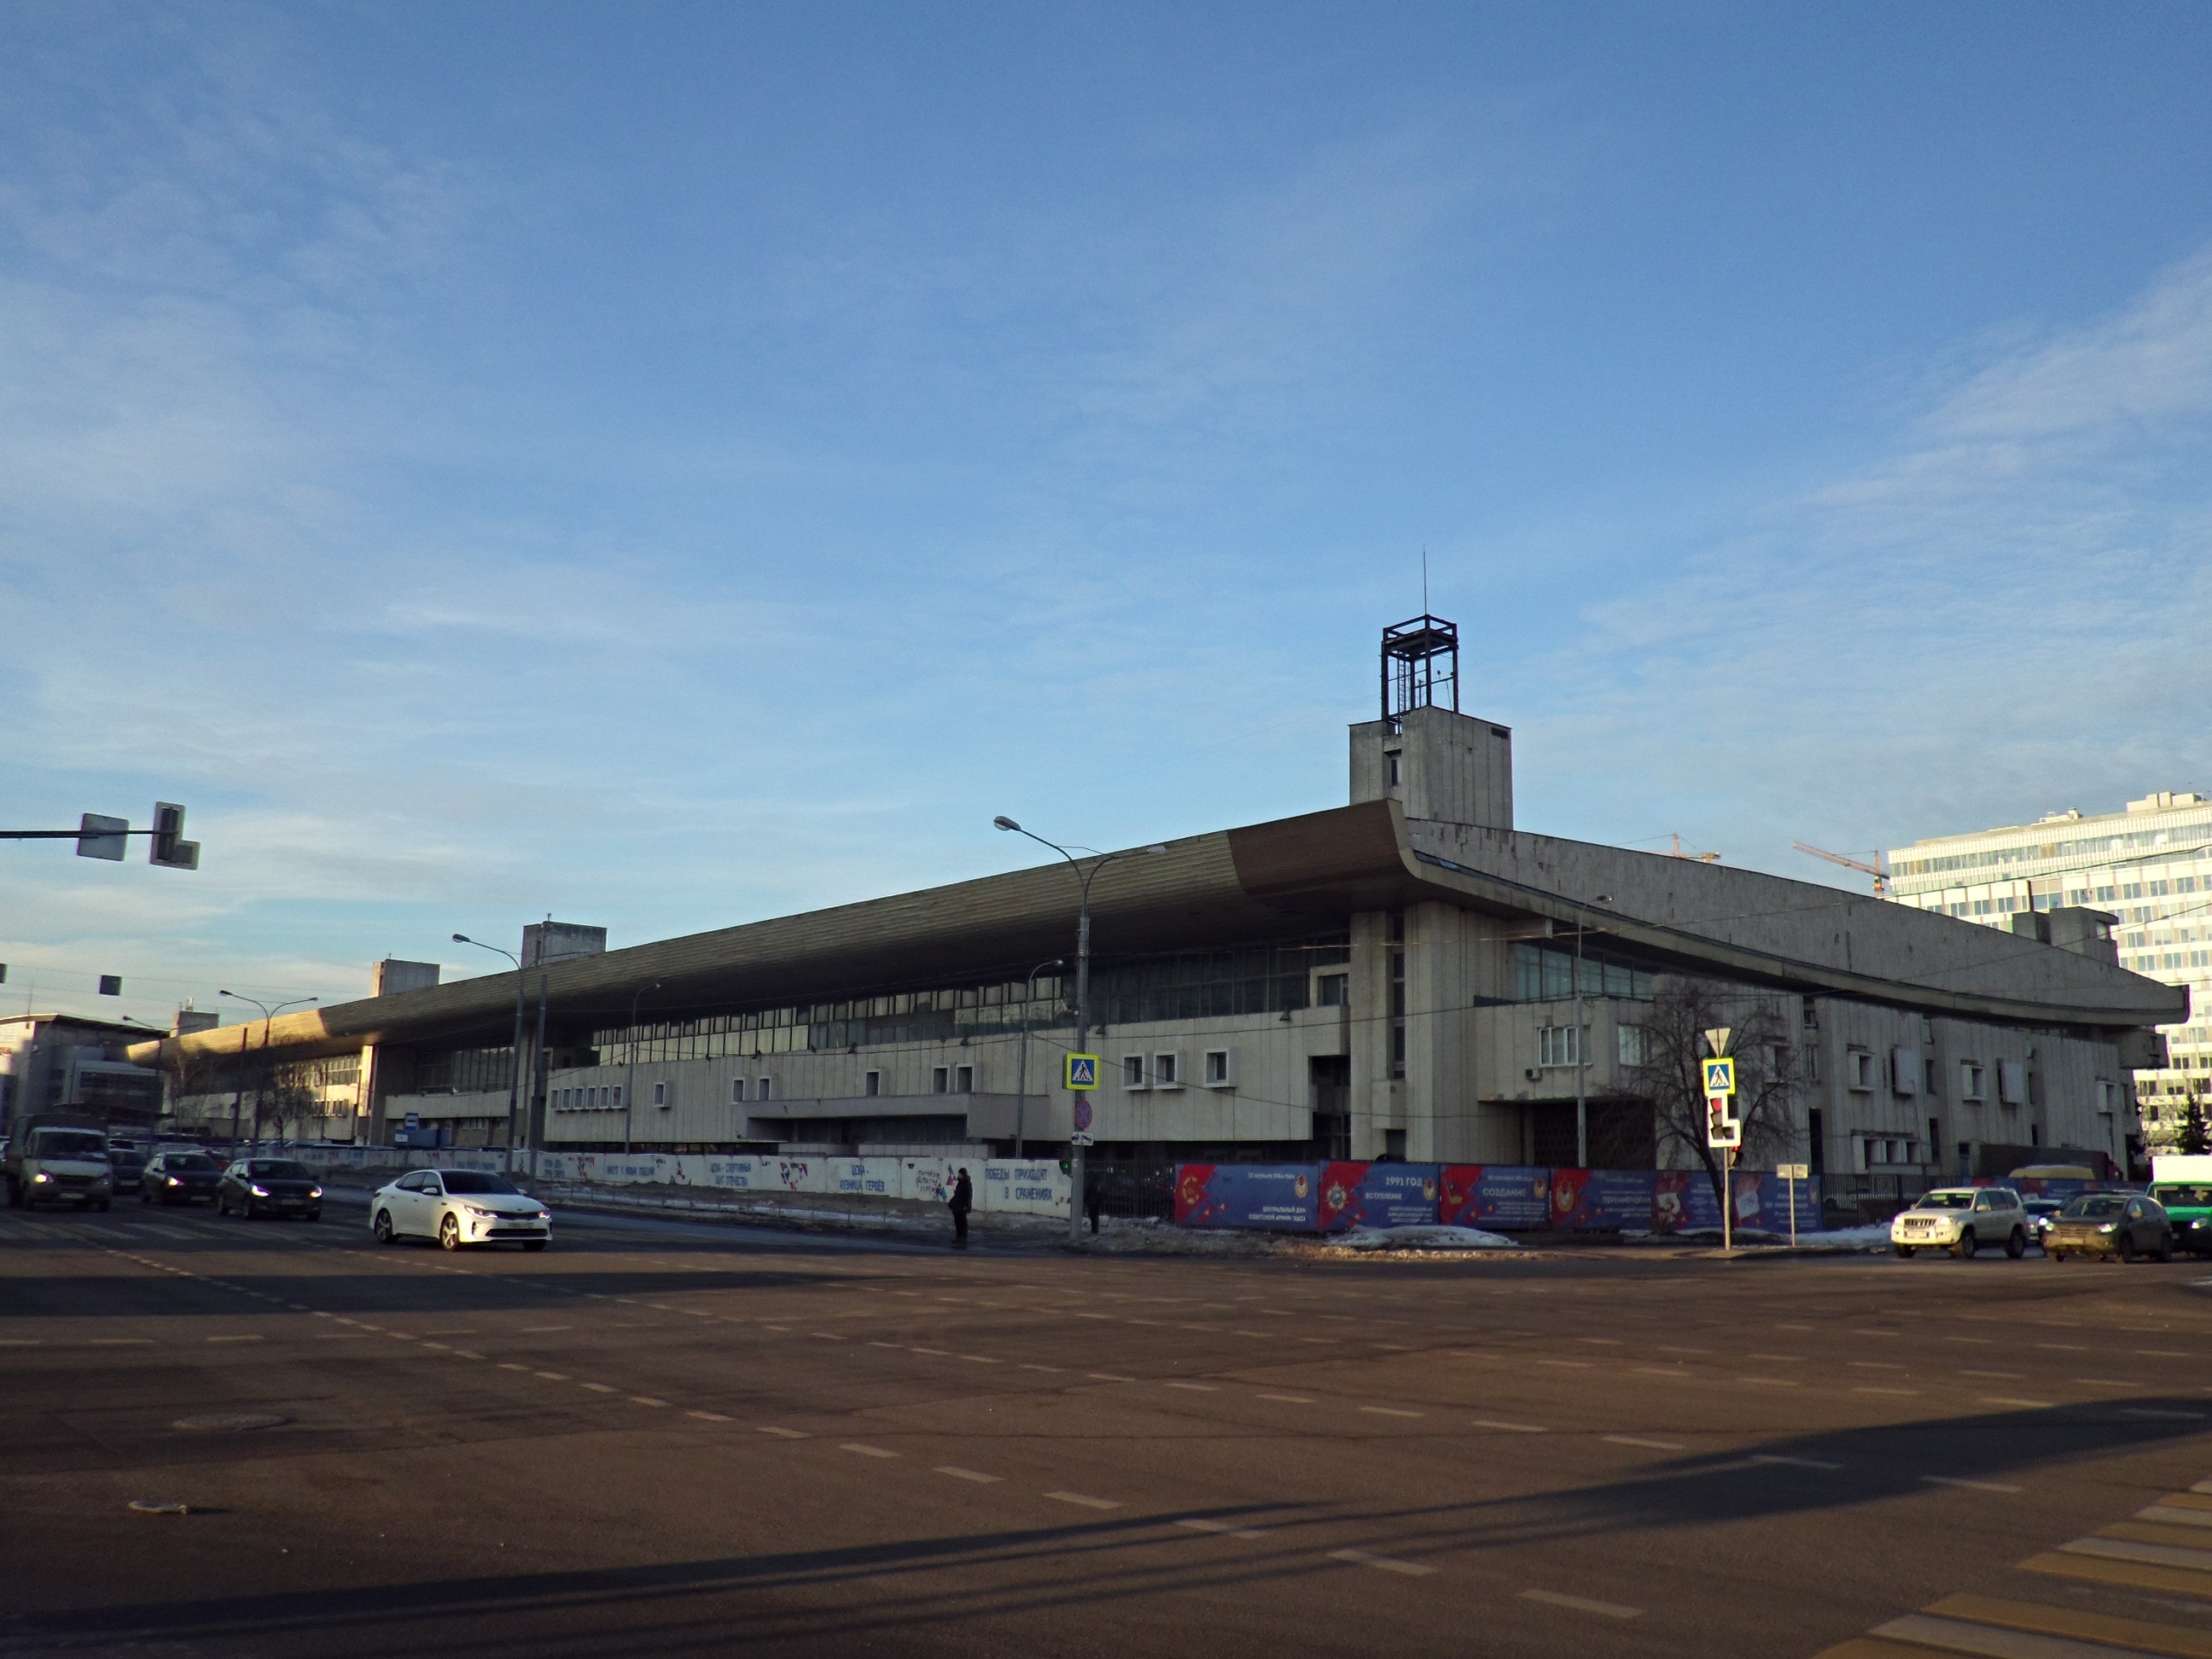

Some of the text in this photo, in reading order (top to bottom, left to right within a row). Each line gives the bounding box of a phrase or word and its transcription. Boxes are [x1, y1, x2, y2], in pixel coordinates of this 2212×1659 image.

[985, 1168, 1048, 1182] ПОБЕДЫ ПРИХОДЯТ
[1386, 1176, 1423, 1187] 1991 ГОД
[1016, 1187, 1053, 1201] СРАЖЕНИЯХ
[1365, 1191, 1402, 1200] ВСТУПЛЕНИЕ
[1482, 1187, 1526, 1197] СОЗДАНИЕ
